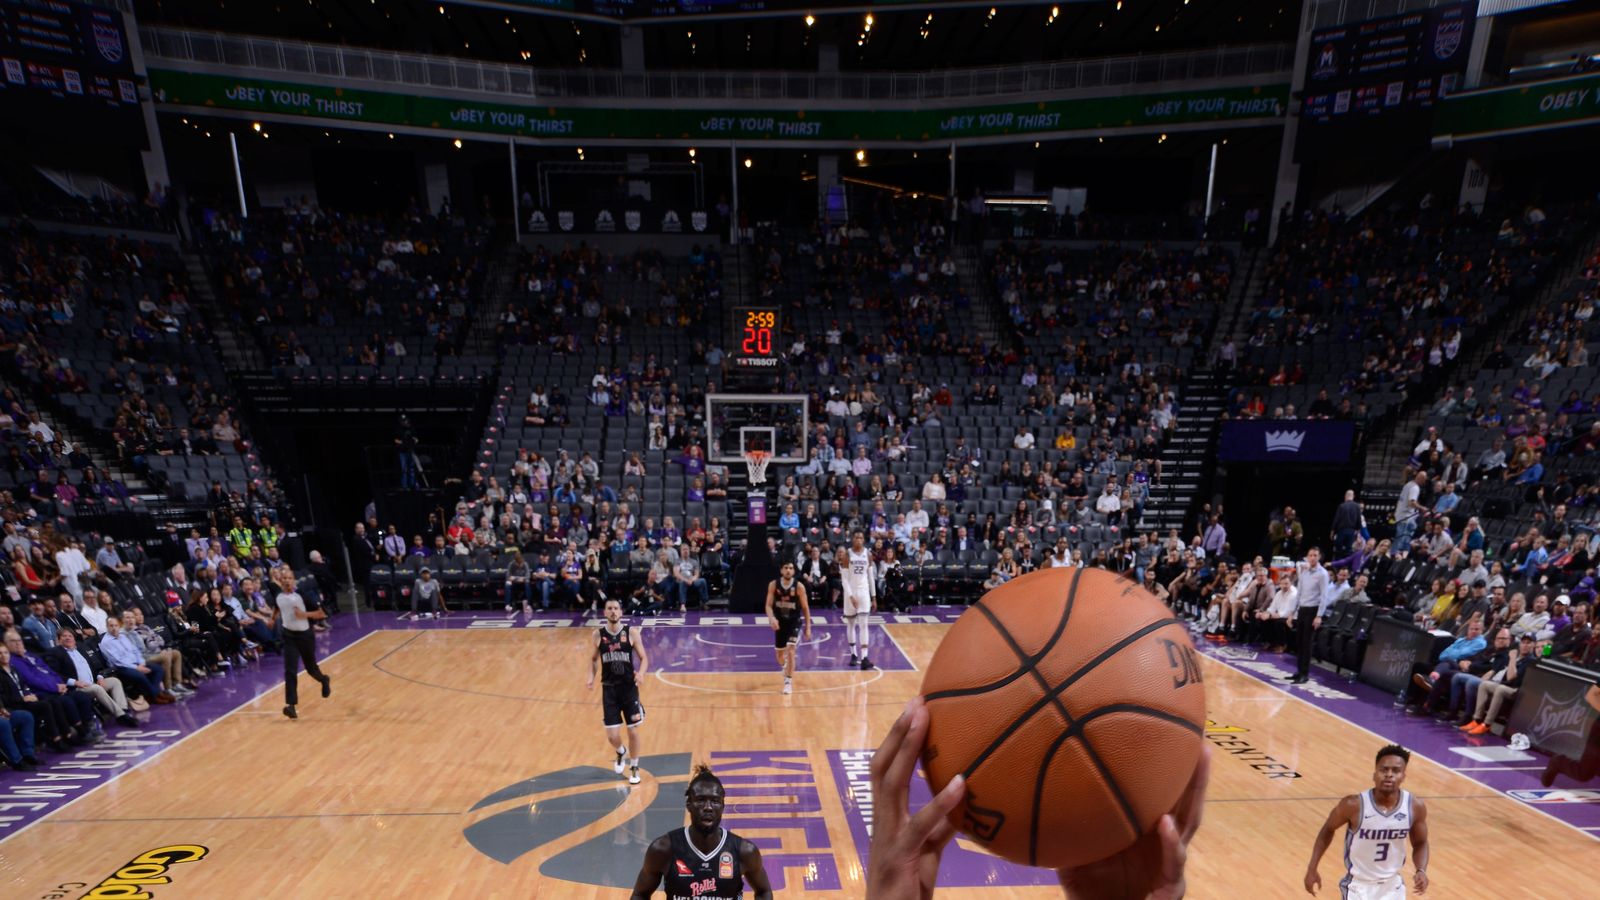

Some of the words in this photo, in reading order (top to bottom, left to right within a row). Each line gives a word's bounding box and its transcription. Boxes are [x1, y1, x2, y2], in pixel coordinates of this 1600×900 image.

[270, 89, 311, 107] YOUR
[314, 98, 364, 116] THIRST
[1186, 96, 1226, 113] YOUR
[1229, 97, 1279, 114] THIRST
[1539, 88, 1590, 112] OBEY
[489, 111, 525, 127] YOUR
[528, 117, 575, 133] THIRST
[738, 117, 775, 131] YOUR
[777, 121, 822, 136] THIRST
[978, 111, 1014, 128] YOUR
[1017, 112, 1061, 129] THIRST
[746, 311, 775, 328] 2:59
[742, 328, 772, 355] 20
[747, 358, 778, 367] TISSOT
[853, 565, 864, 575] 22
[1386, 661, 1410, 677] MVP
[1534, 699, 1586, 735] Sprite
[1206, 734, 1303, 779] CENTER
[1359, 828, 1411, 841] KINGS
[1374, 843, 1390, 862] 3
